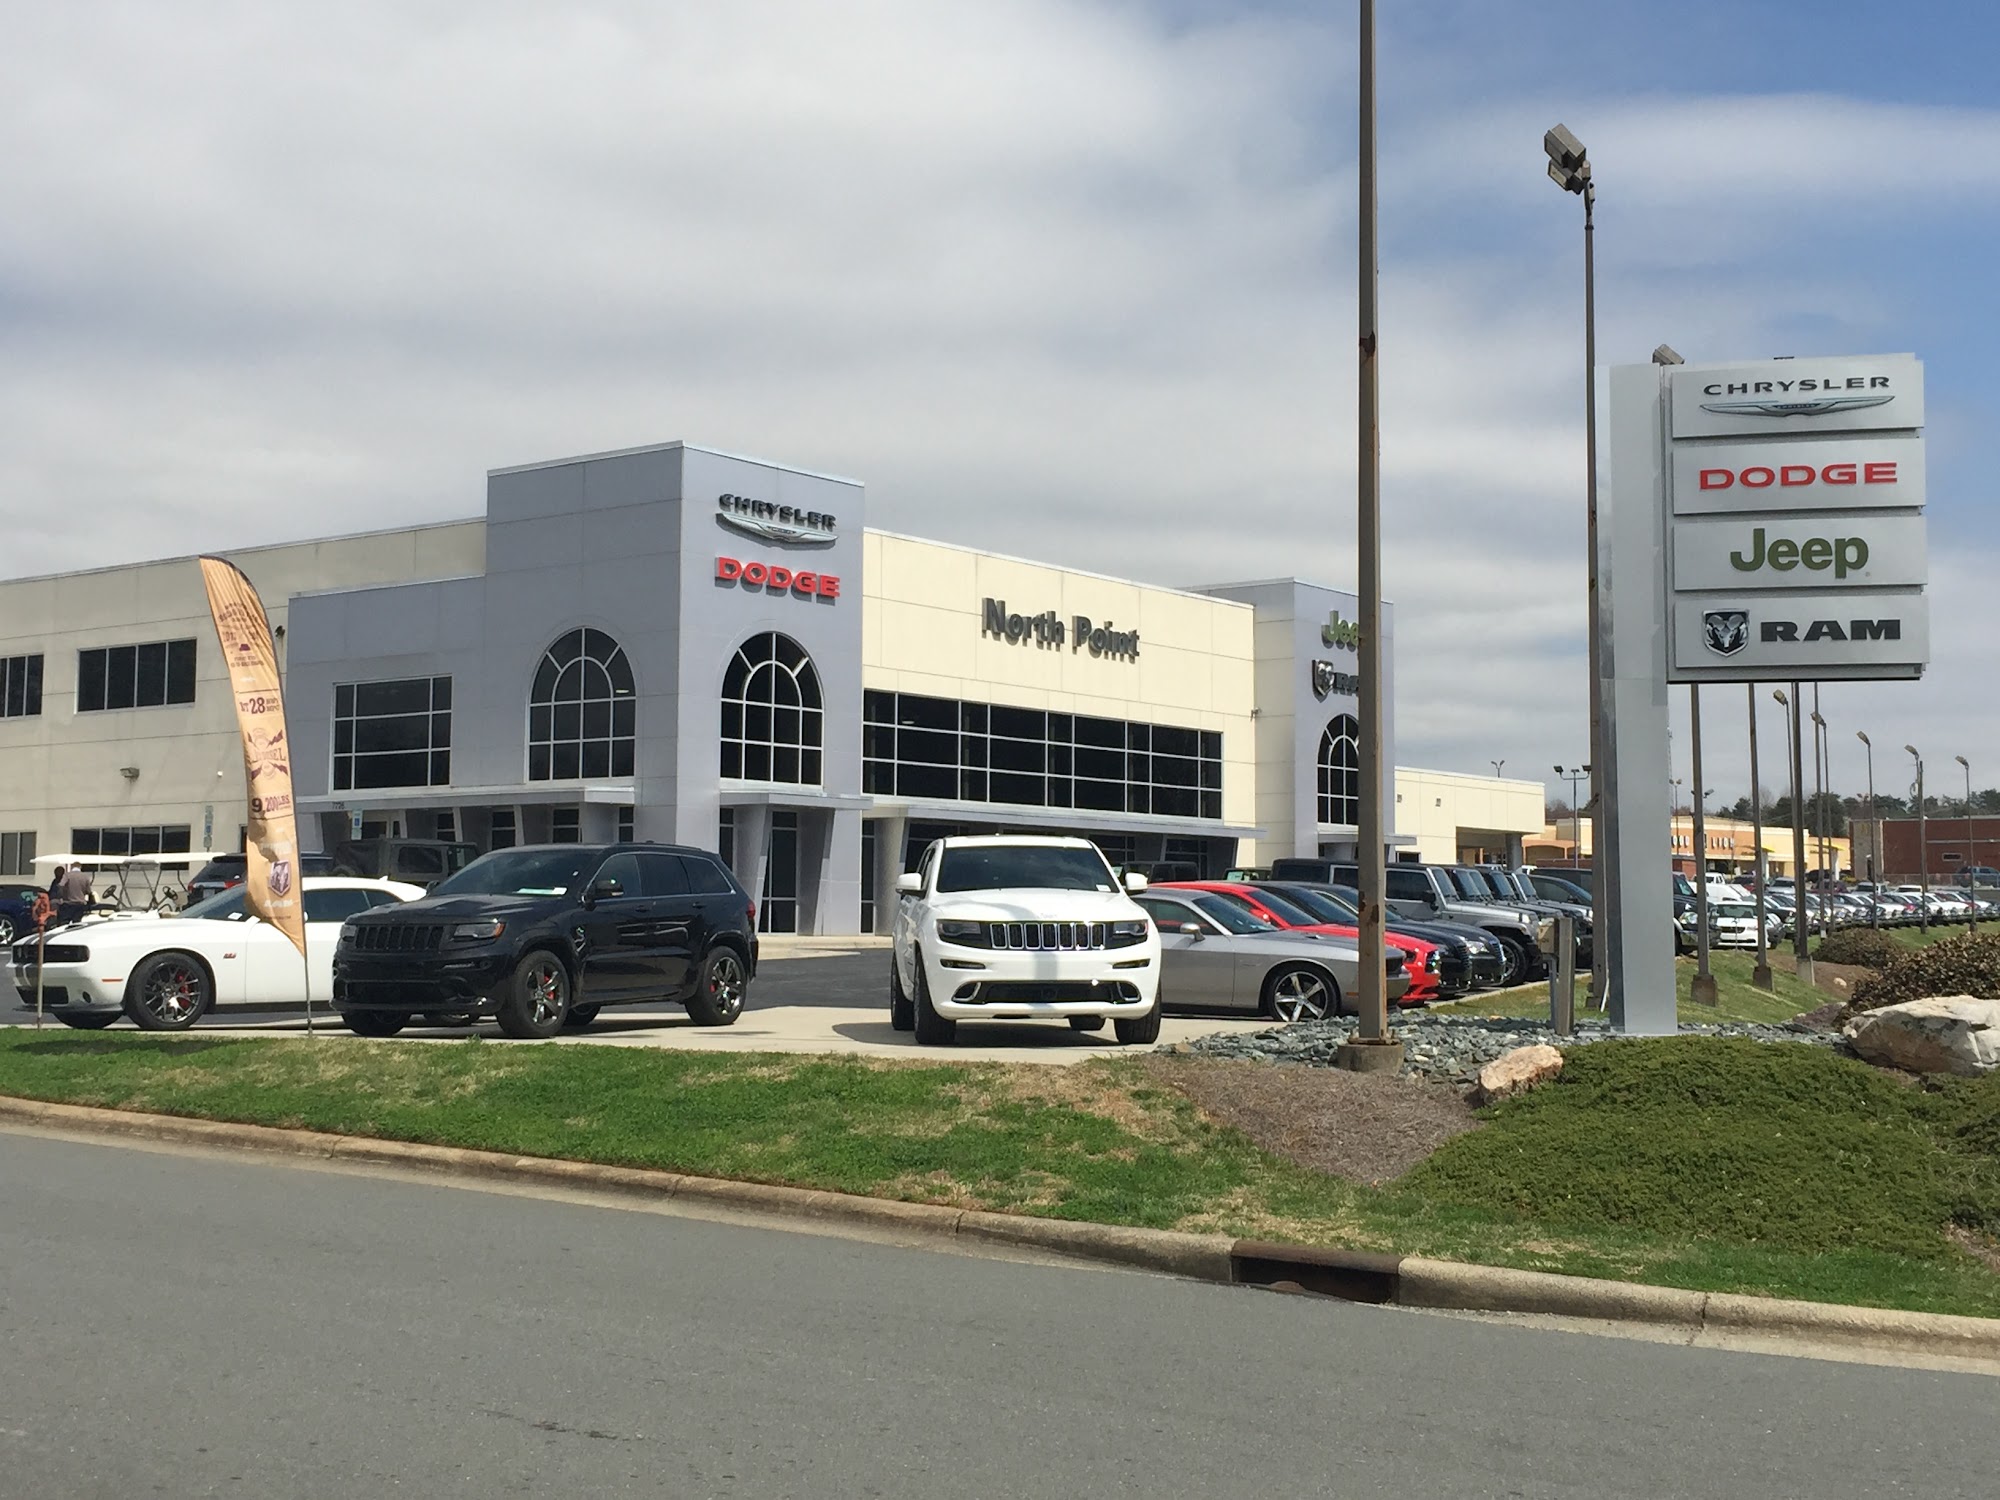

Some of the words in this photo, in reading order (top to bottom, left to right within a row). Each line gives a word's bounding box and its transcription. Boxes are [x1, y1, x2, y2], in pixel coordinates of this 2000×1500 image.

[1703, 376, 1890, 395] CHRYSLER
[1700, 462, 1898, 490] DODGE
[718, 494, 837, 529] CHRYSLER
[1730, 528, 1869, 579] Jeep
[717, 557, 840, 598] DODGE
[982, 598, 1064, 645] North
[1072, 615, 1140, 657] Point
[1321, 610, 1359, 646] Jee
[1760, 619, 1901, 642] RAM
[249, 697, 266, 714] 28
[1671, 835, 1690, 848] OOD
